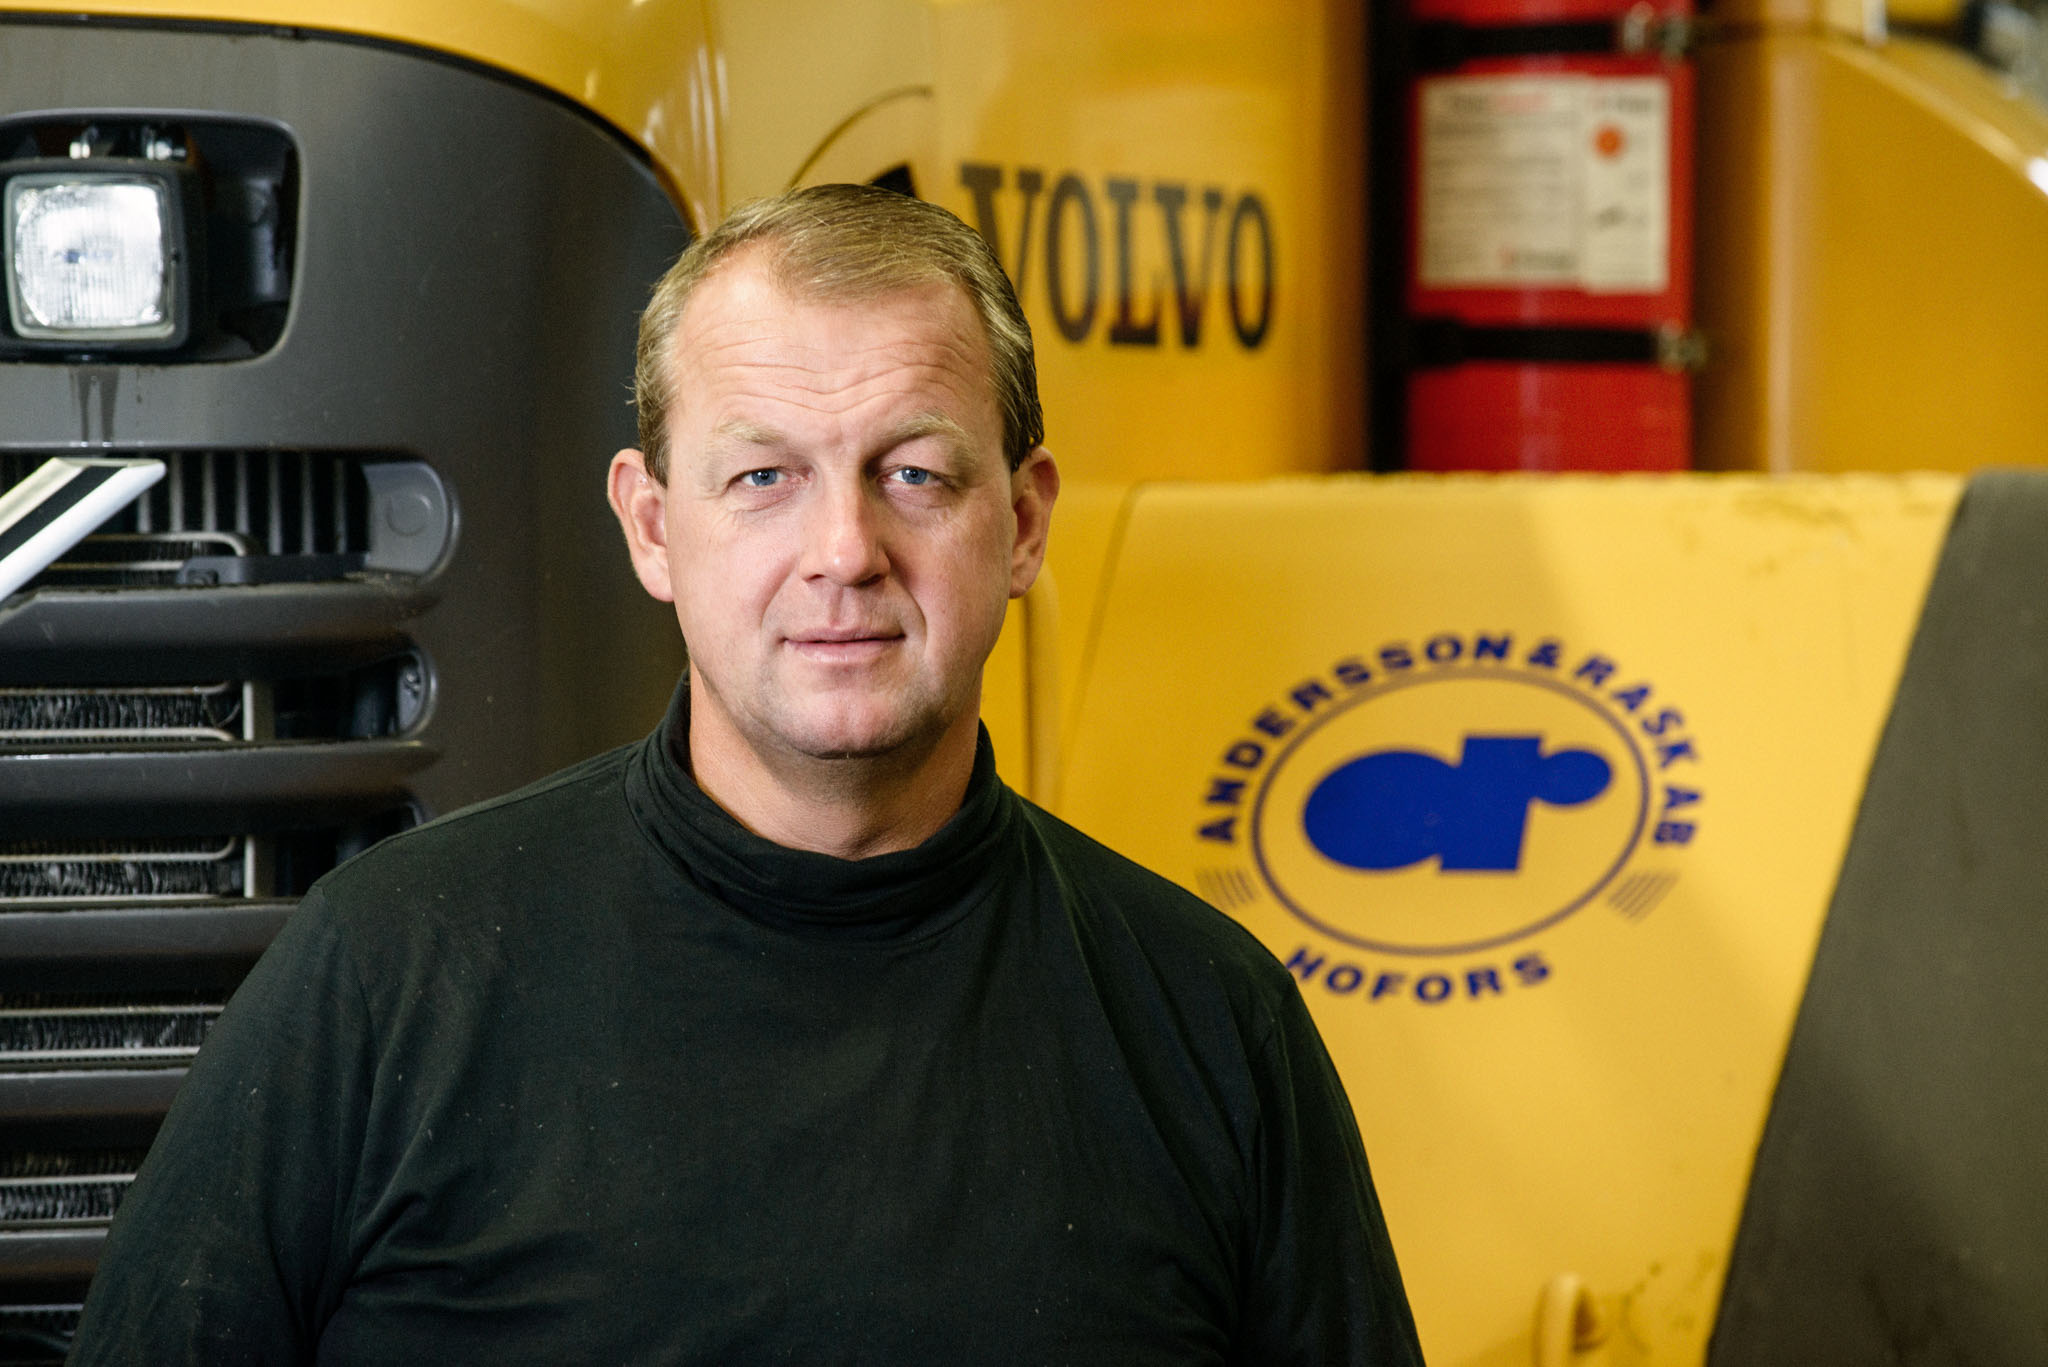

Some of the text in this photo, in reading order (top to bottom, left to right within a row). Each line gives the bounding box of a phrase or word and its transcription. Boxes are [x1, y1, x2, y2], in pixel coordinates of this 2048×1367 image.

[959, 161, 1275, 351] VOLVO
[1196, 632, 1512, 846] ANDERSSON
[1574, 653, 1702, 771] RASK
[1651, 783, 1702, 847] AB
[1286, 946, 1553, 1006] HOFORS
